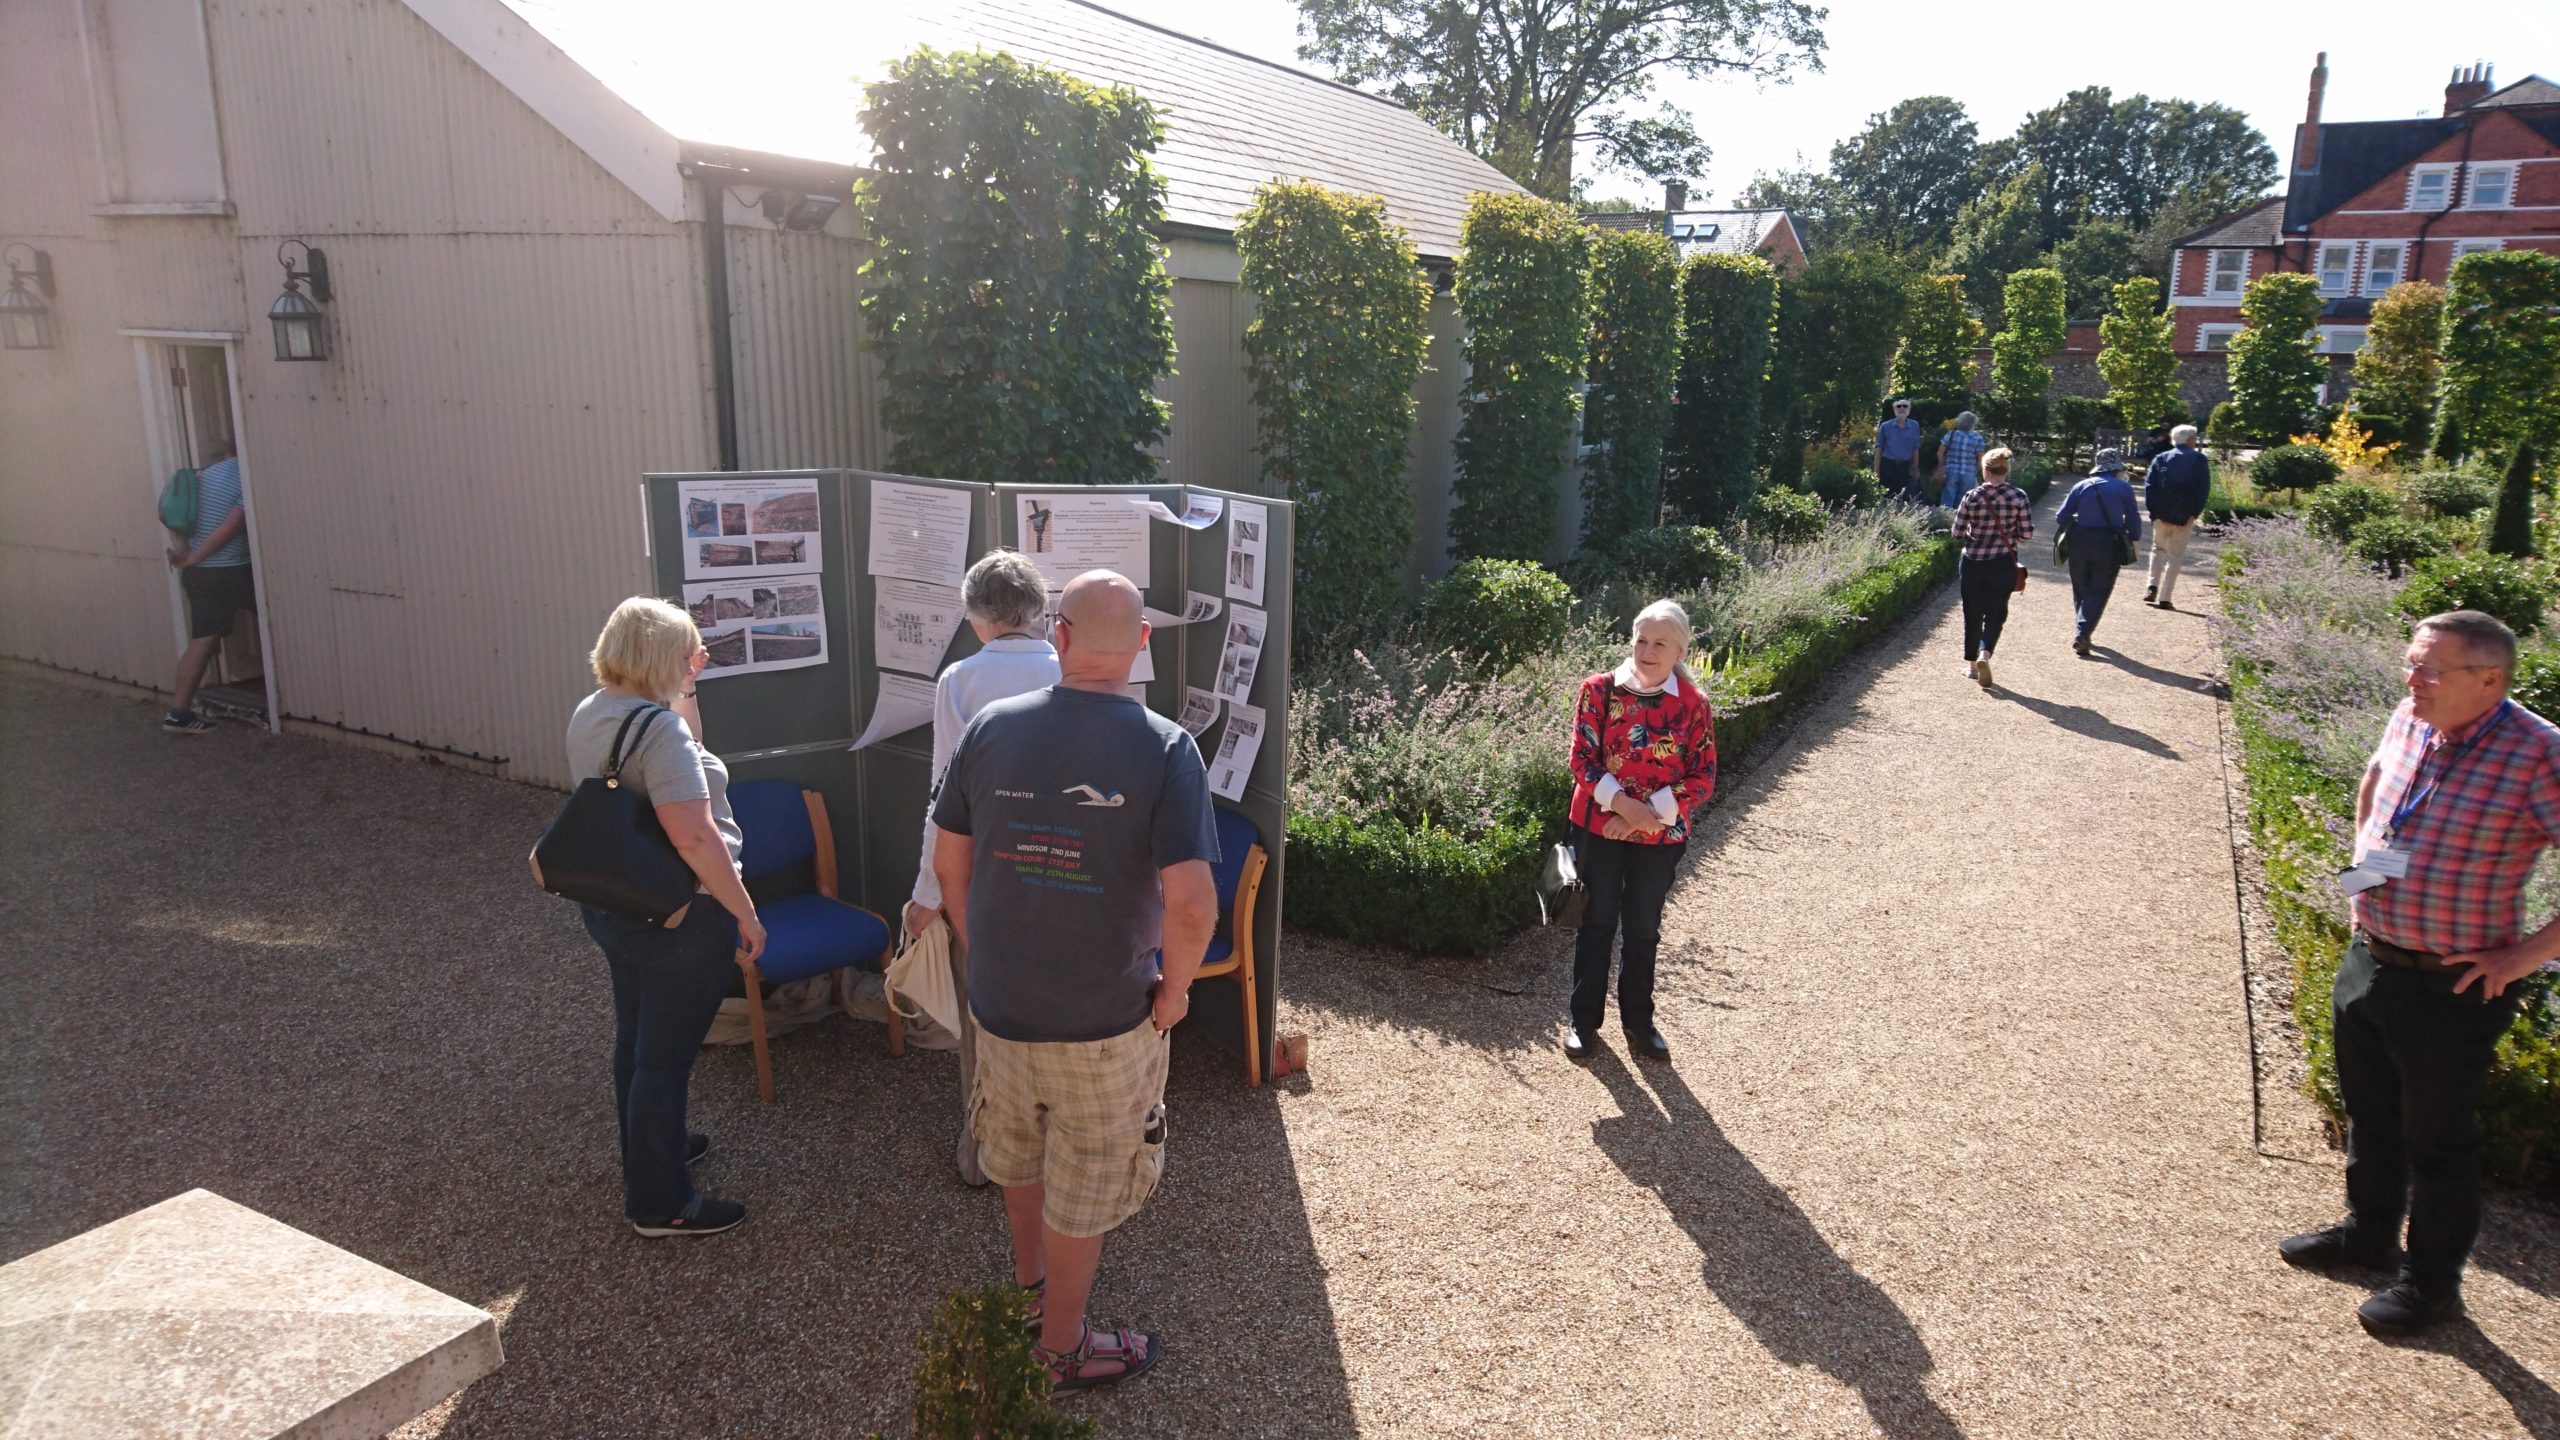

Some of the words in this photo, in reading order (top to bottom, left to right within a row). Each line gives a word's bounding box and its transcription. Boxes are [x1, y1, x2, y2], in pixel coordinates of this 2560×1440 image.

[995, 789, 1010, 797] OPEN
[1012, 791, 1034, 799] WATER
[1017, 843, 1048, 853] WINDSOR
[1050, 847, 1064, 856] 2ND
[1064, 850, 1081, 859] JUNE
[1023, 855, 1045, 864] COURT
[1064, 861, 1081, 869] JULY
[1064, 872, 1093, 882] AUGUST
